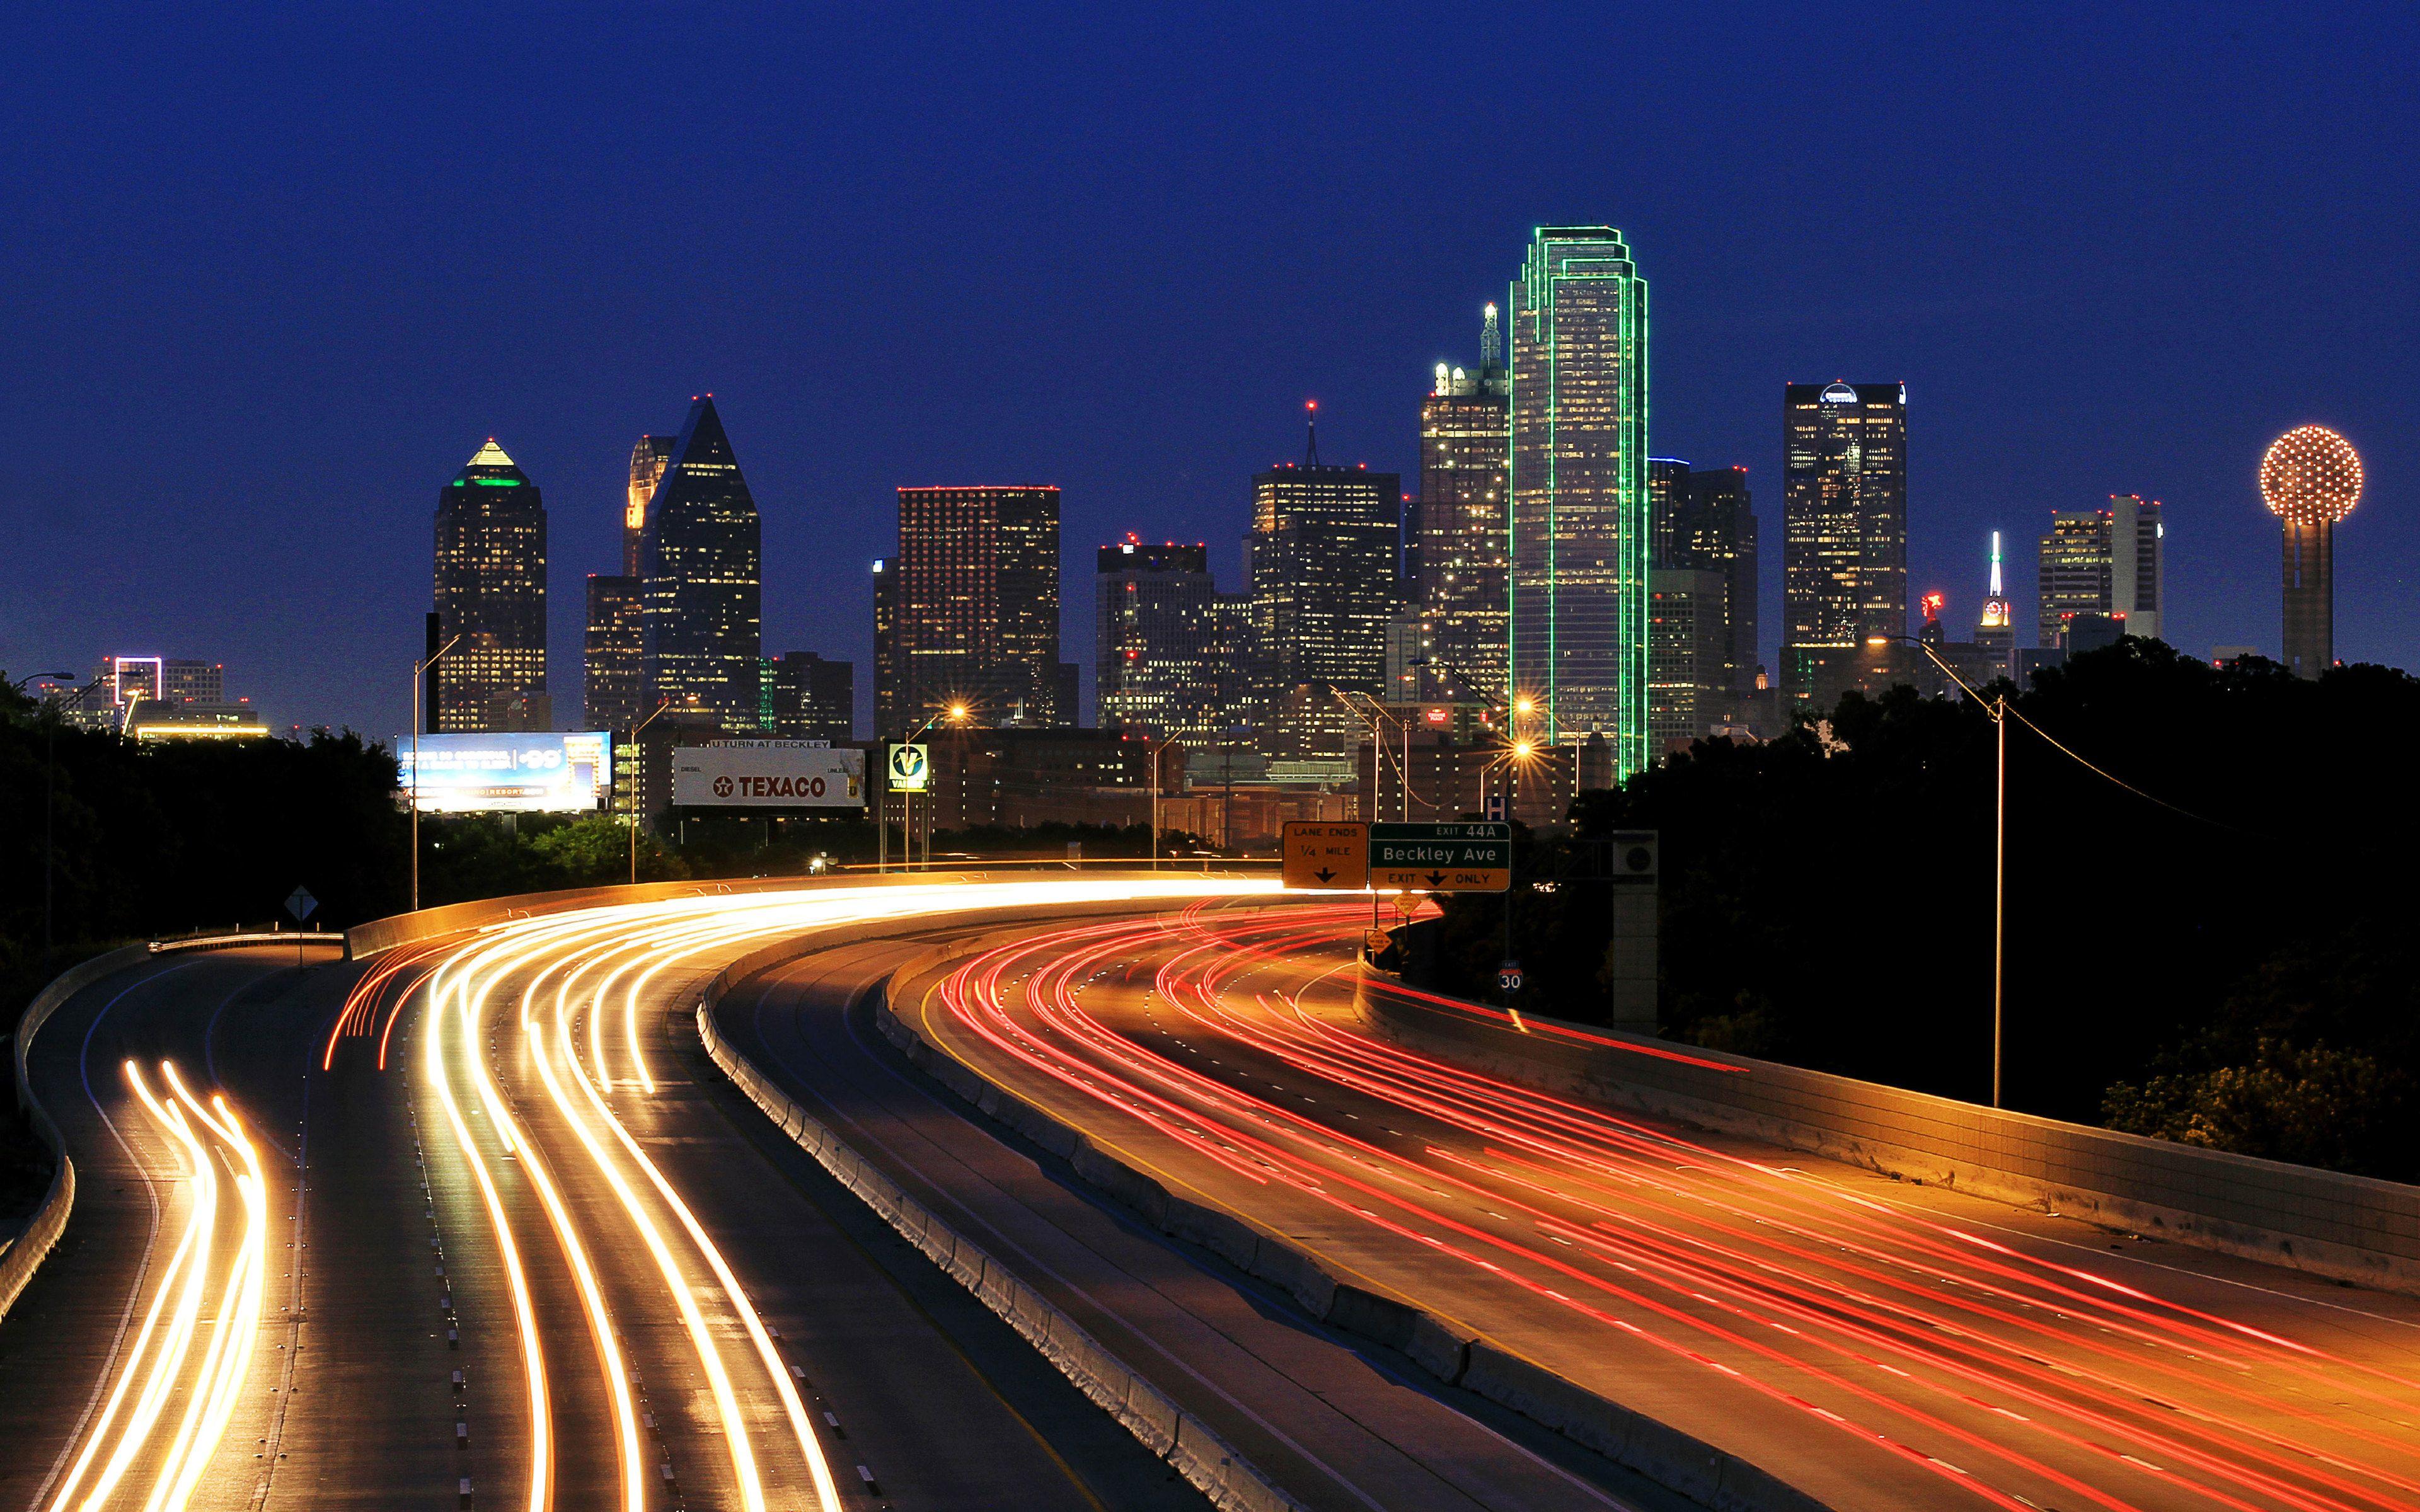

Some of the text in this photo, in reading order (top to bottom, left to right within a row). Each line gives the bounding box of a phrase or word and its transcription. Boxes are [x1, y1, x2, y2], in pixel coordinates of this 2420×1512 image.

[775, 740, 829, 748] BECKLEY
[739, 776, 826, 798] TEXACO
[1487, 798, 1505, 820] H
[1294, 828, 1357, 837] LANE ENDS
[1437, 825, 1496, 837] EXIT 44A
[1301, 845, 1351, 857] 1/4 MILE
[1384, 847, 1496, 864] Beckley Ave
[1388, 874, 1490, 883] EXIT ONLY
[1501, 975, 1520, 988] 30
